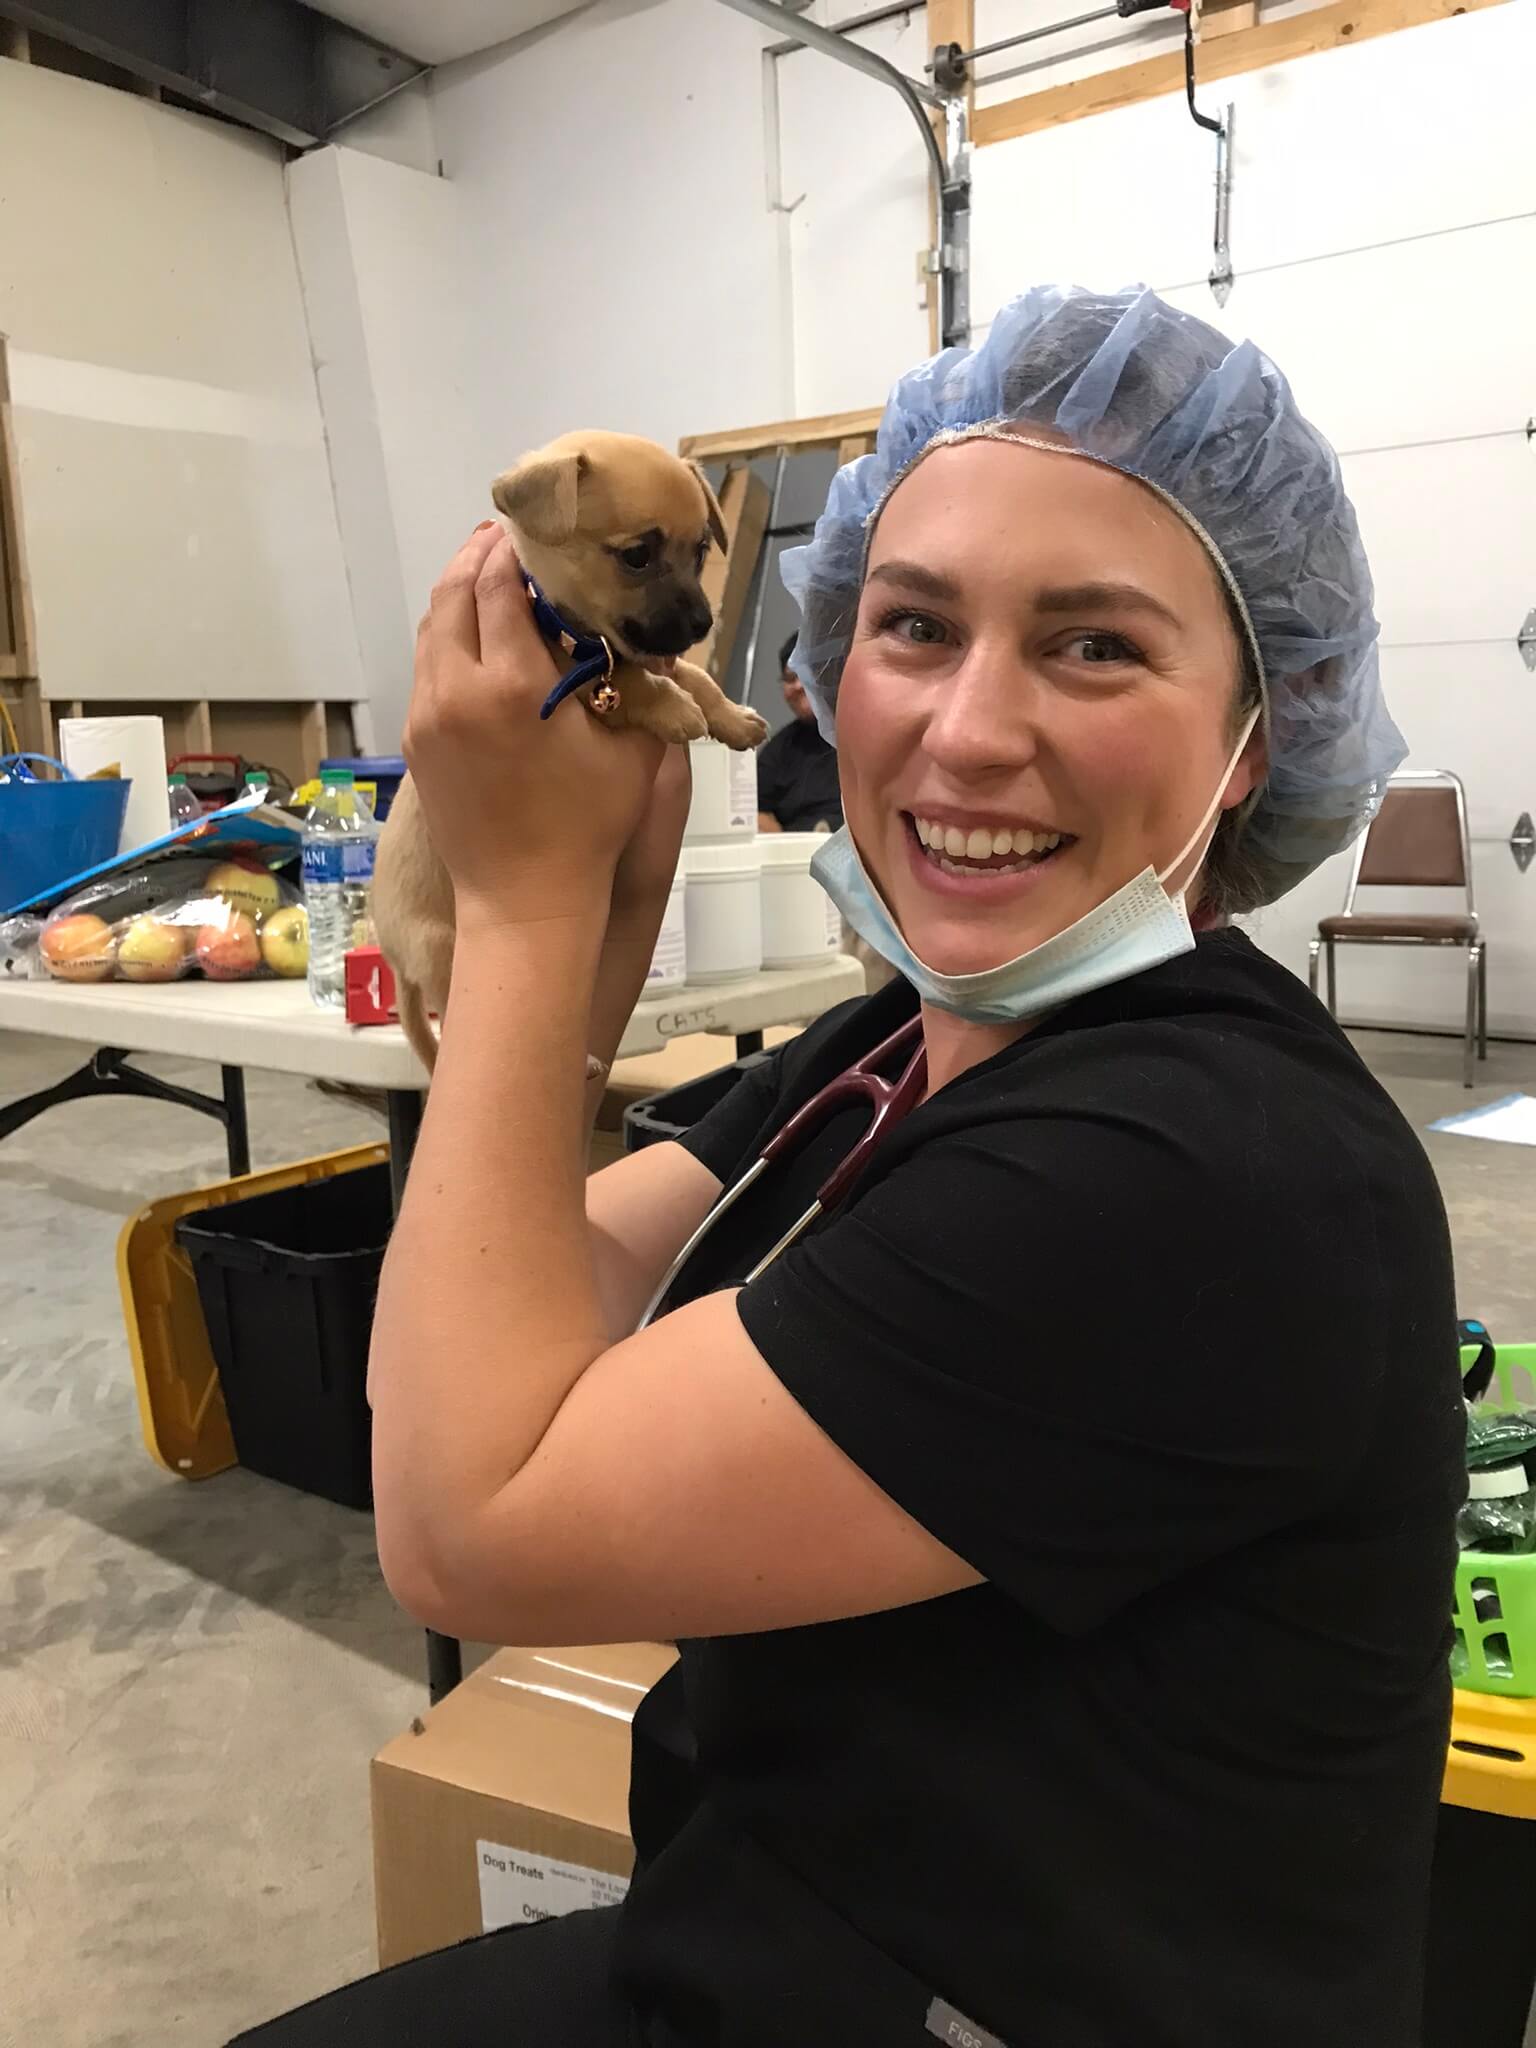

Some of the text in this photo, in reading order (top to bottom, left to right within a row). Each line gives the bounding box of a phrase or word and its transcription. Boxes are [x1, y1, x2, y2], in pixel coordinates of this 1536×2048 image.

[656, 1006, 716, 1034] CATS
[483, 1854, 506, 1872] Dog
[509, 1861, 544, 1880] Treats
[948, 2021, 983, 2048] FIGS
